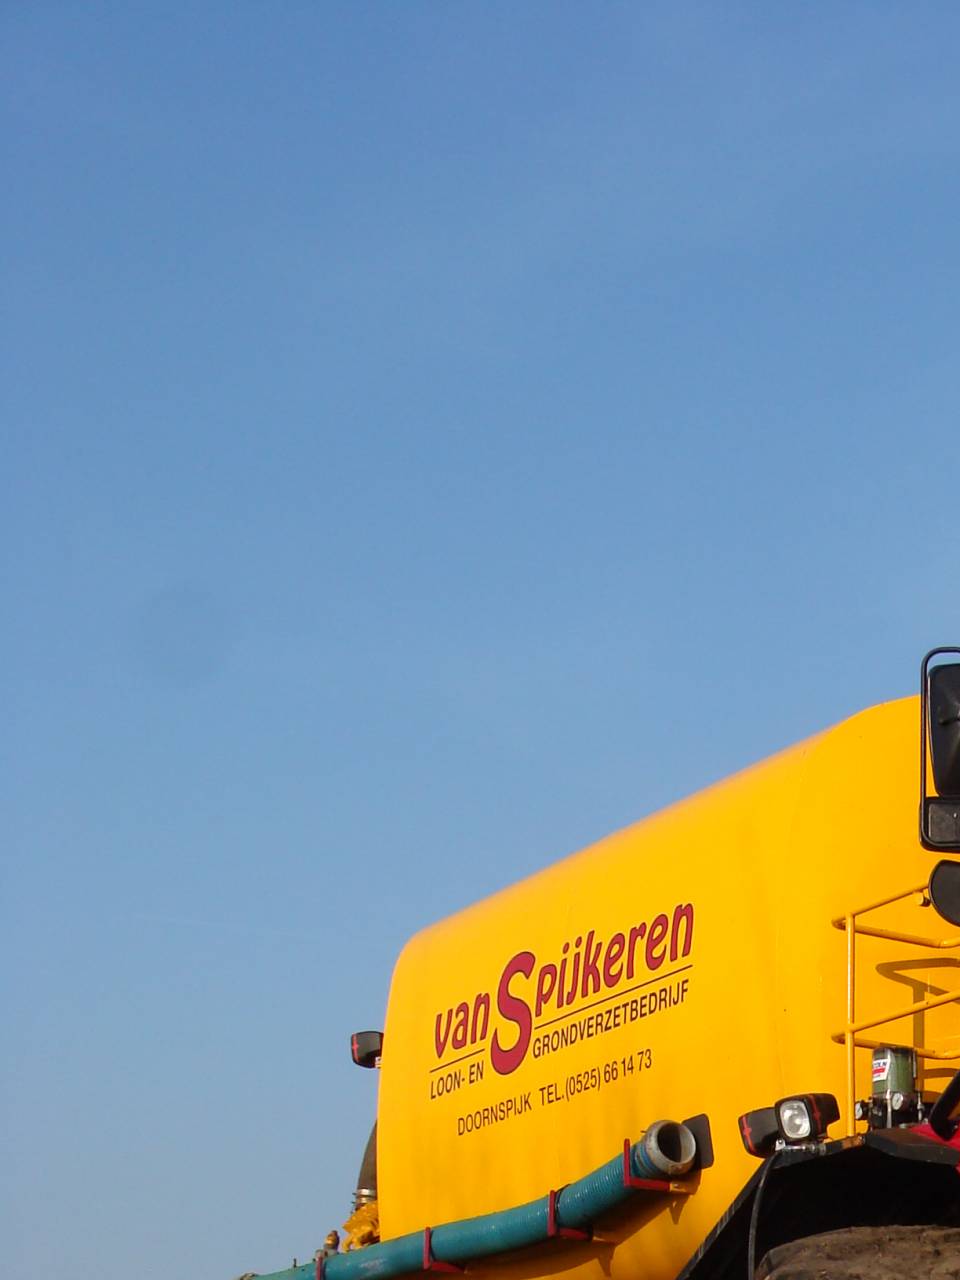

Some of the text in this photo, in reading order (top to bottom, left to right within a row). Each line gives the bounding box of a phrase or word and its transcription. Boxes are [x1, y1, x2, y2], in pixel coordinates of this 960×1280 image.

[430, 979, 690, 1100] LOON- EN GRONDVERZETBEDRIJF
[434, 903, 694, 1076] van Spijkeren
[457, 1091, 532, 1136] DOORNSPIJK
[603, 1060, 619, 1083] 66
[621, 1055, 634, 1077] 14
[637, 1048, 652, 1072] 73
